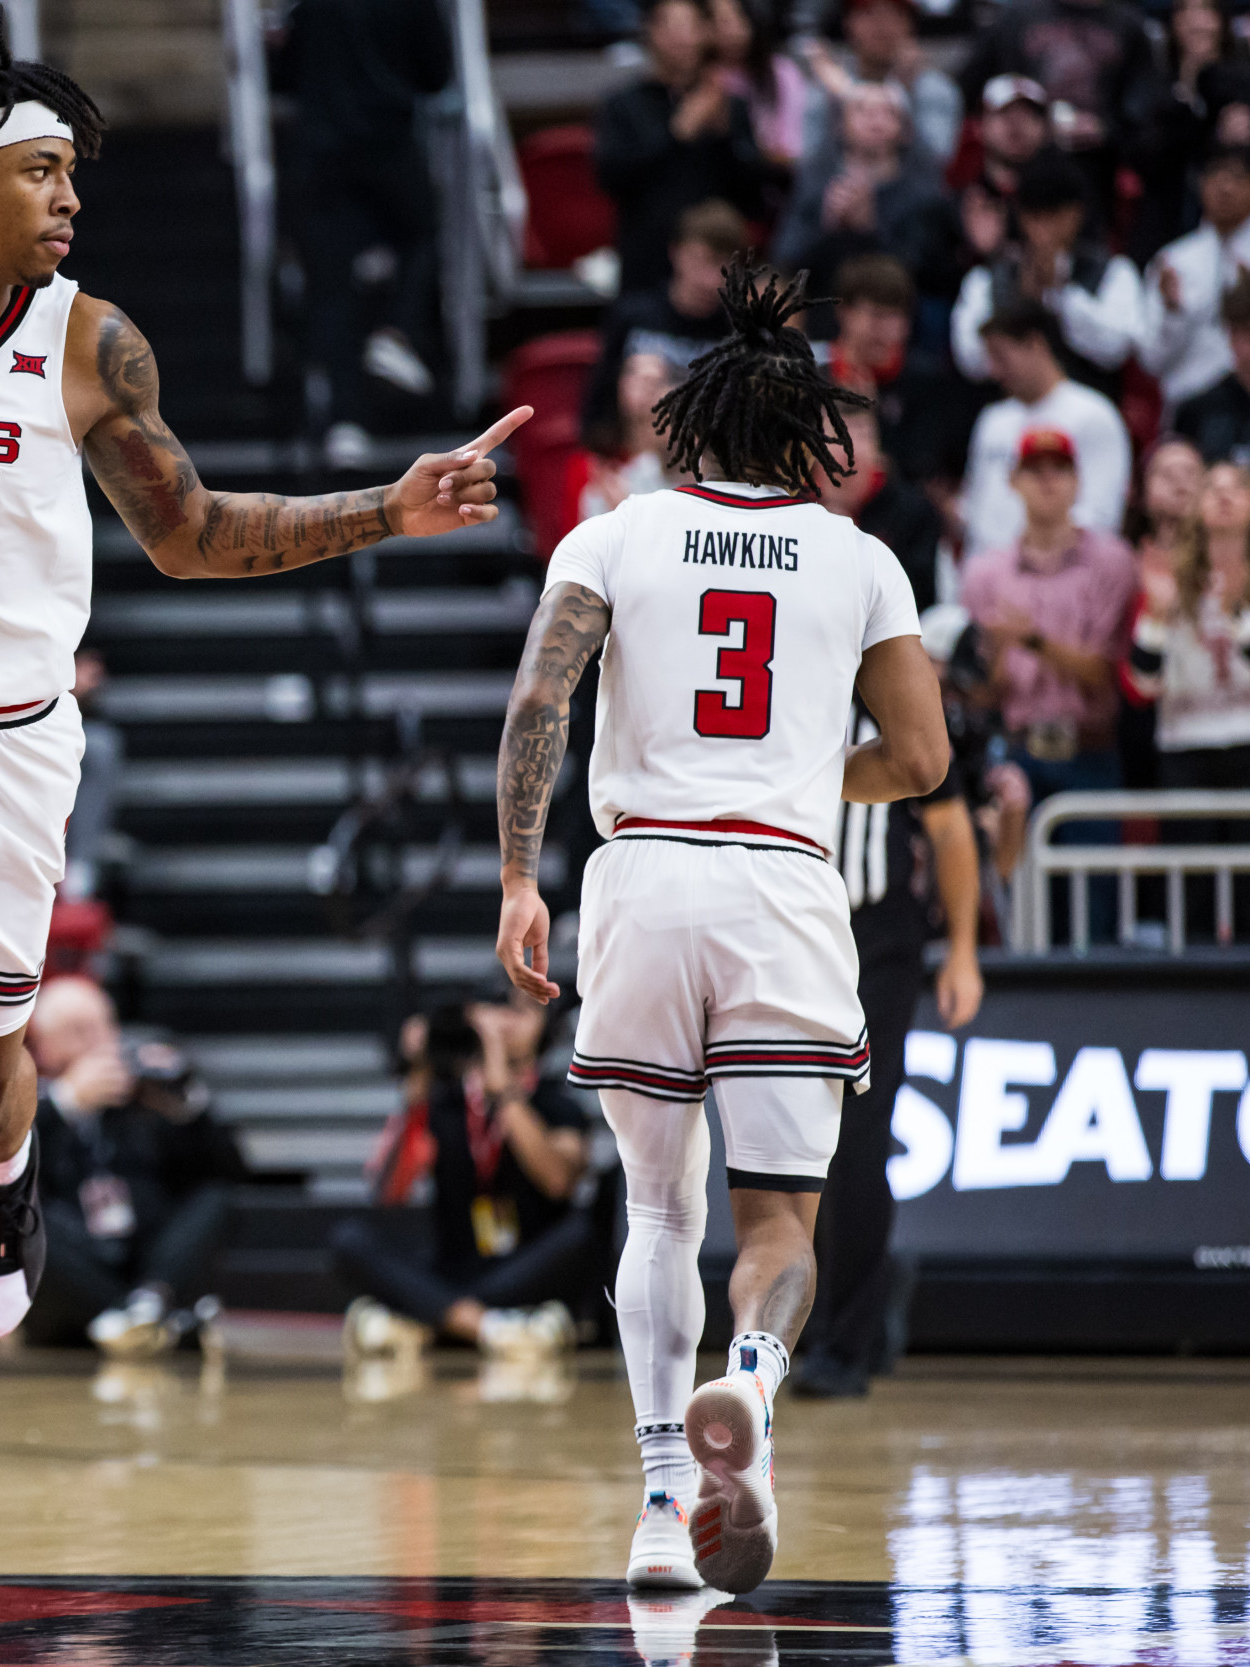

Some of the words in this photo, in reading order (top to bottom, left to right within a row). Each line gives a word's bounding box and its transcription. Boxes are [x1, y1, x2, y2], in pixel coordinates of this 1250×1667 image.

[683, 529, 798, 571] HAWKINS
[693, 588, 777, 740] 3
[886, 1030, 1250, 1201] SEAT
